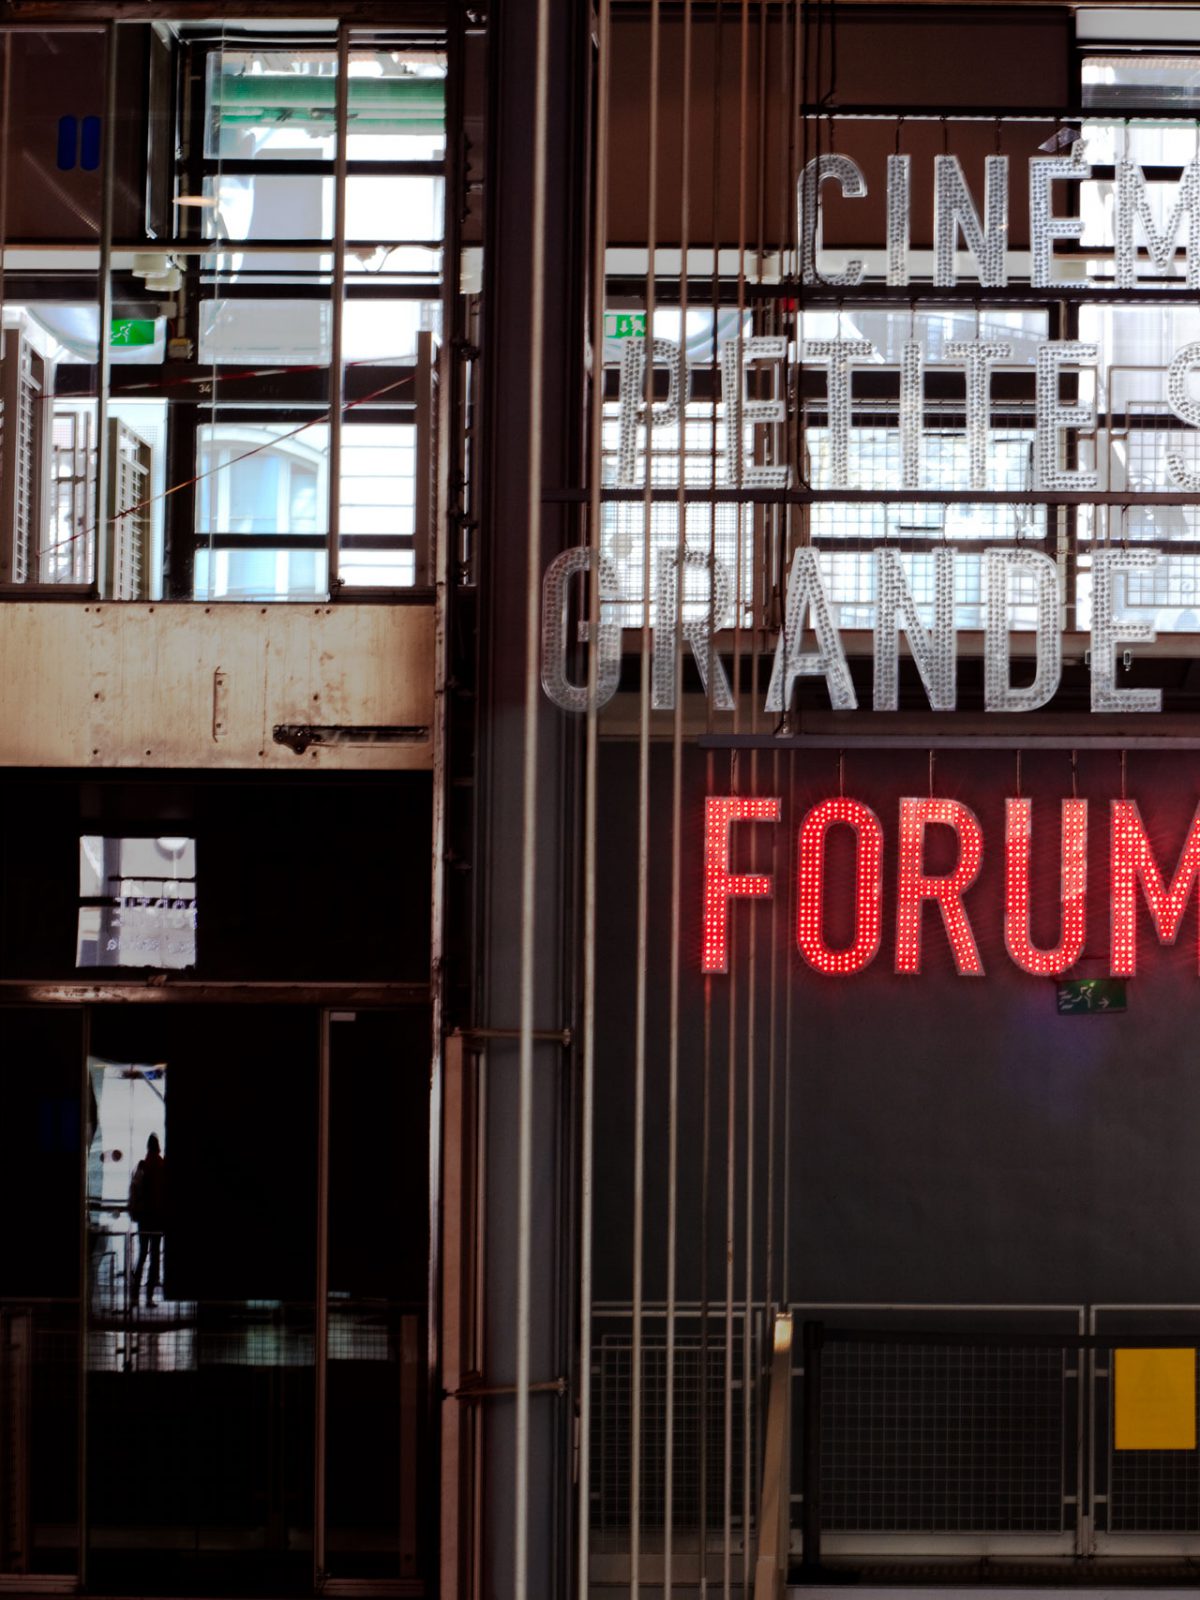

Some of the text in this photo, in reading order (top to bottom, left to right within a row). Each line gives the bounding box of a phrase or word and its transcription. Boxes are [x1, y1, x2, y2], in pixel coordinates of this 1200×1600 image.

[198, 383, 211, 394] 34
[616, 336, 1098, 490] PETITE
[541, 546, 1163, 712] GRANDE
